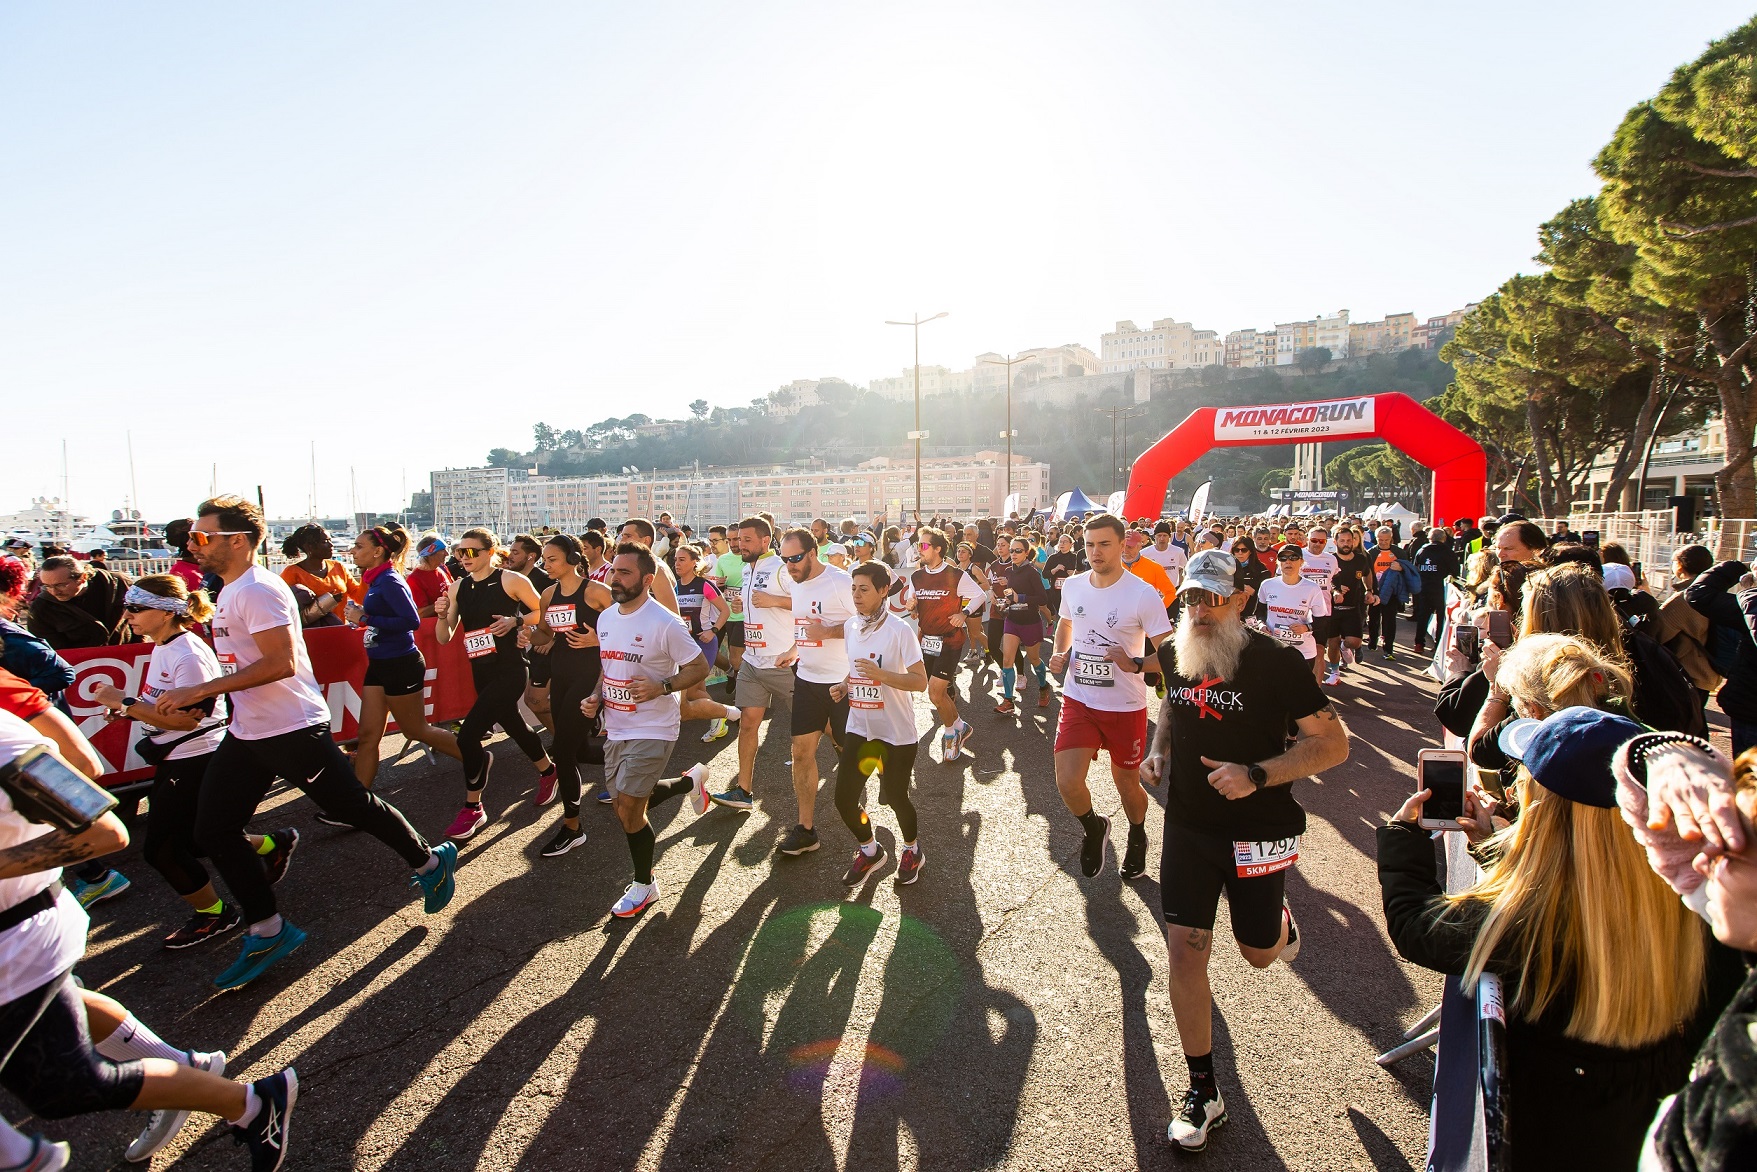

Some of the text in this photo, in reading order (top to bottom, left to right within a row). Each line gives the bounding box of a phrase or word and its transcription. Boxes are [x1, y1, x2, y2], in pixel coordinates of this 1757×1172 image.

[1220, 401, 1368, 428] MONACORUN
[1280, 426, 1310, 434] FÉVRIER
[1310, 425, 1330, 433] 2023
[549, 611, 573, 624] 1137
[745, 630, 763, 640] 1340
[468, 635, 491, 650] 1361
[1082, 662, 1110, 676] 2153
[607, 686, 631, 701] 1330
[855, 686, 880, 699] 1142
[1169, 686, 1244, 707] WOLFPACK
[1213, 702, 1244, 712] TEAM
[1131, 738, 1141, 759] 5
[1254, 836, 1297, 858] 1292
[1246, 866, 1267, 875] 5KM
